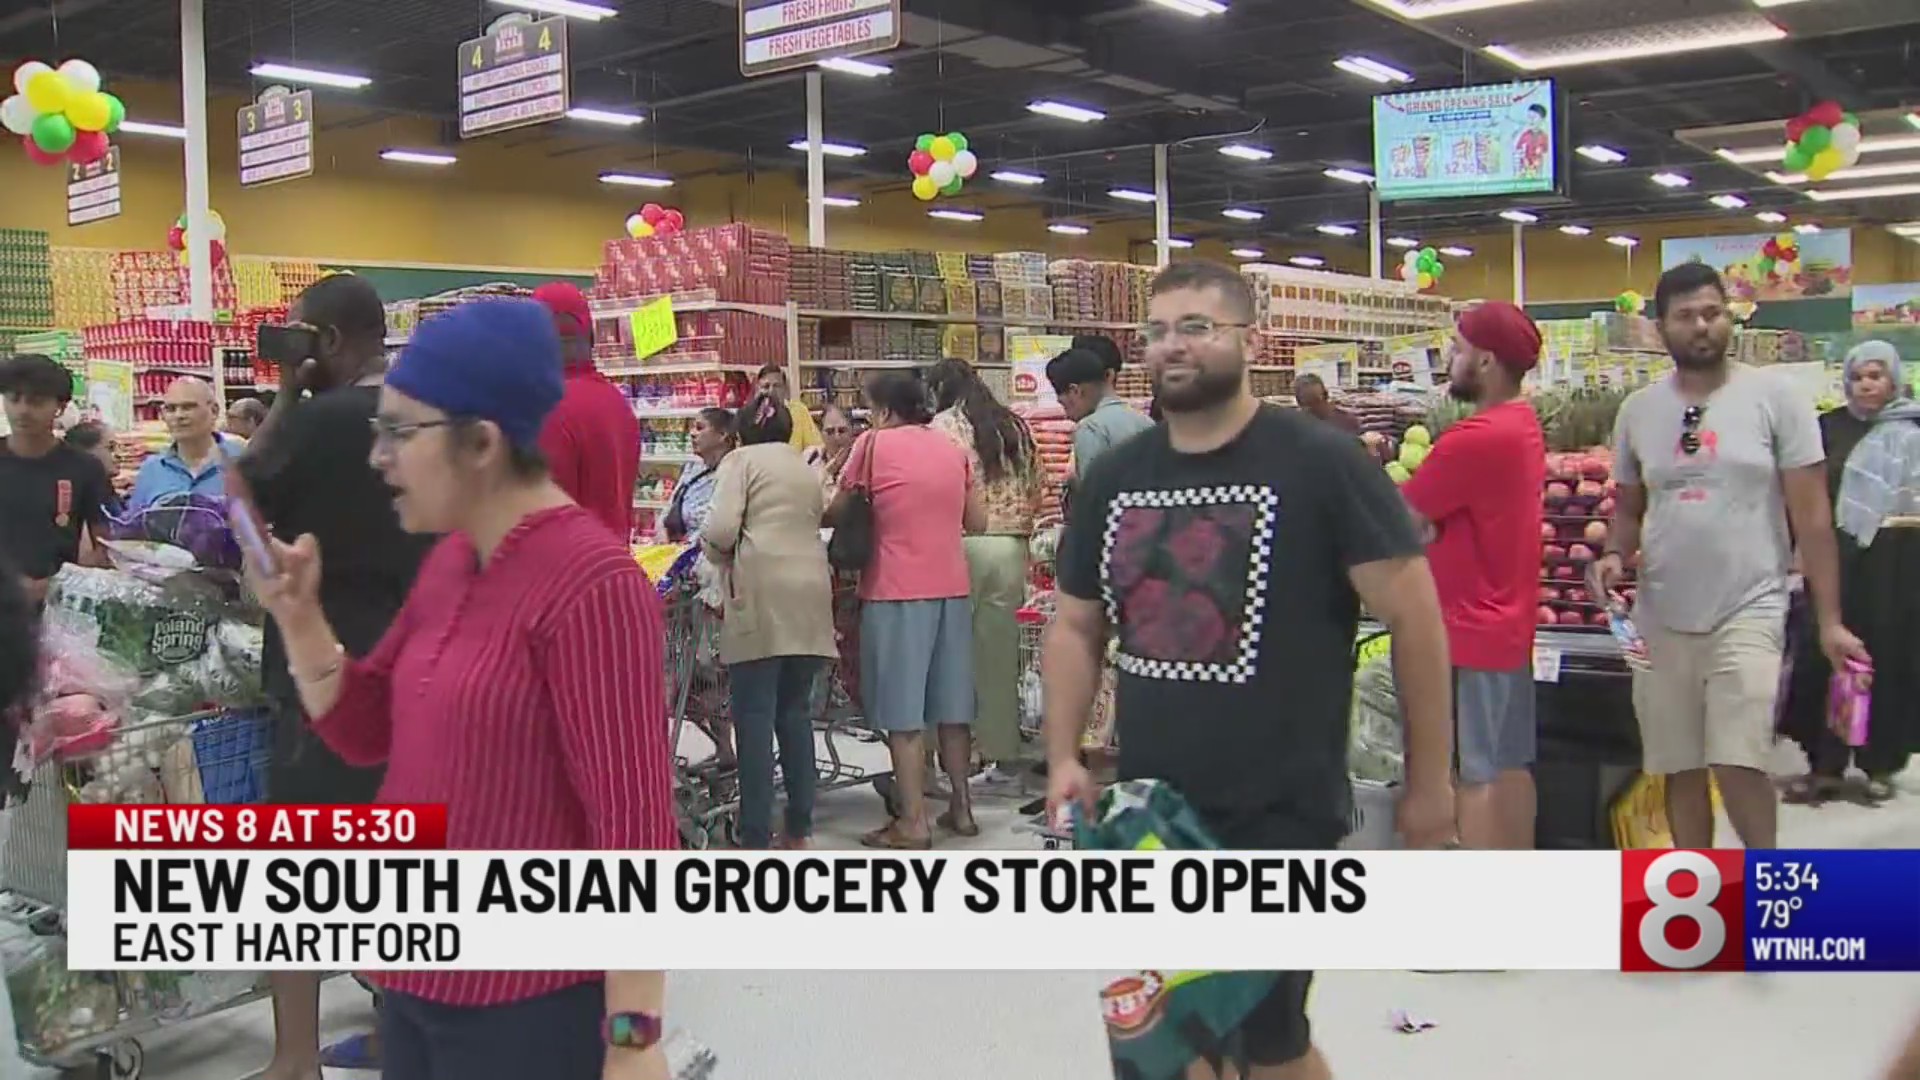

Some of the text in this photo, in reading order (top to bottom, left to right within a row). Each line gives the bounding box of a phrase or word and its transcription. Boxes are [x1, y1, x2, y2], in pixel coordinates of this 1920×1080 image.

[782, 0, 815, 23] FRESH
[538, 25, 551, 51] 4
[768, 18, 871, 57] FRESH VEGETABLES
[471, 45, 482, 70] 4
[293, 99, 302, 121] 3
[1406, 100, 1441, 114] GRAND
[1443, 96, 1485, 109] OPENING
[247, 111, 256, 133] 3
[105, 152, 114, 171] 2
[154, 617, 206, 637] Poland
[151, 631, 205, 655] Spring
